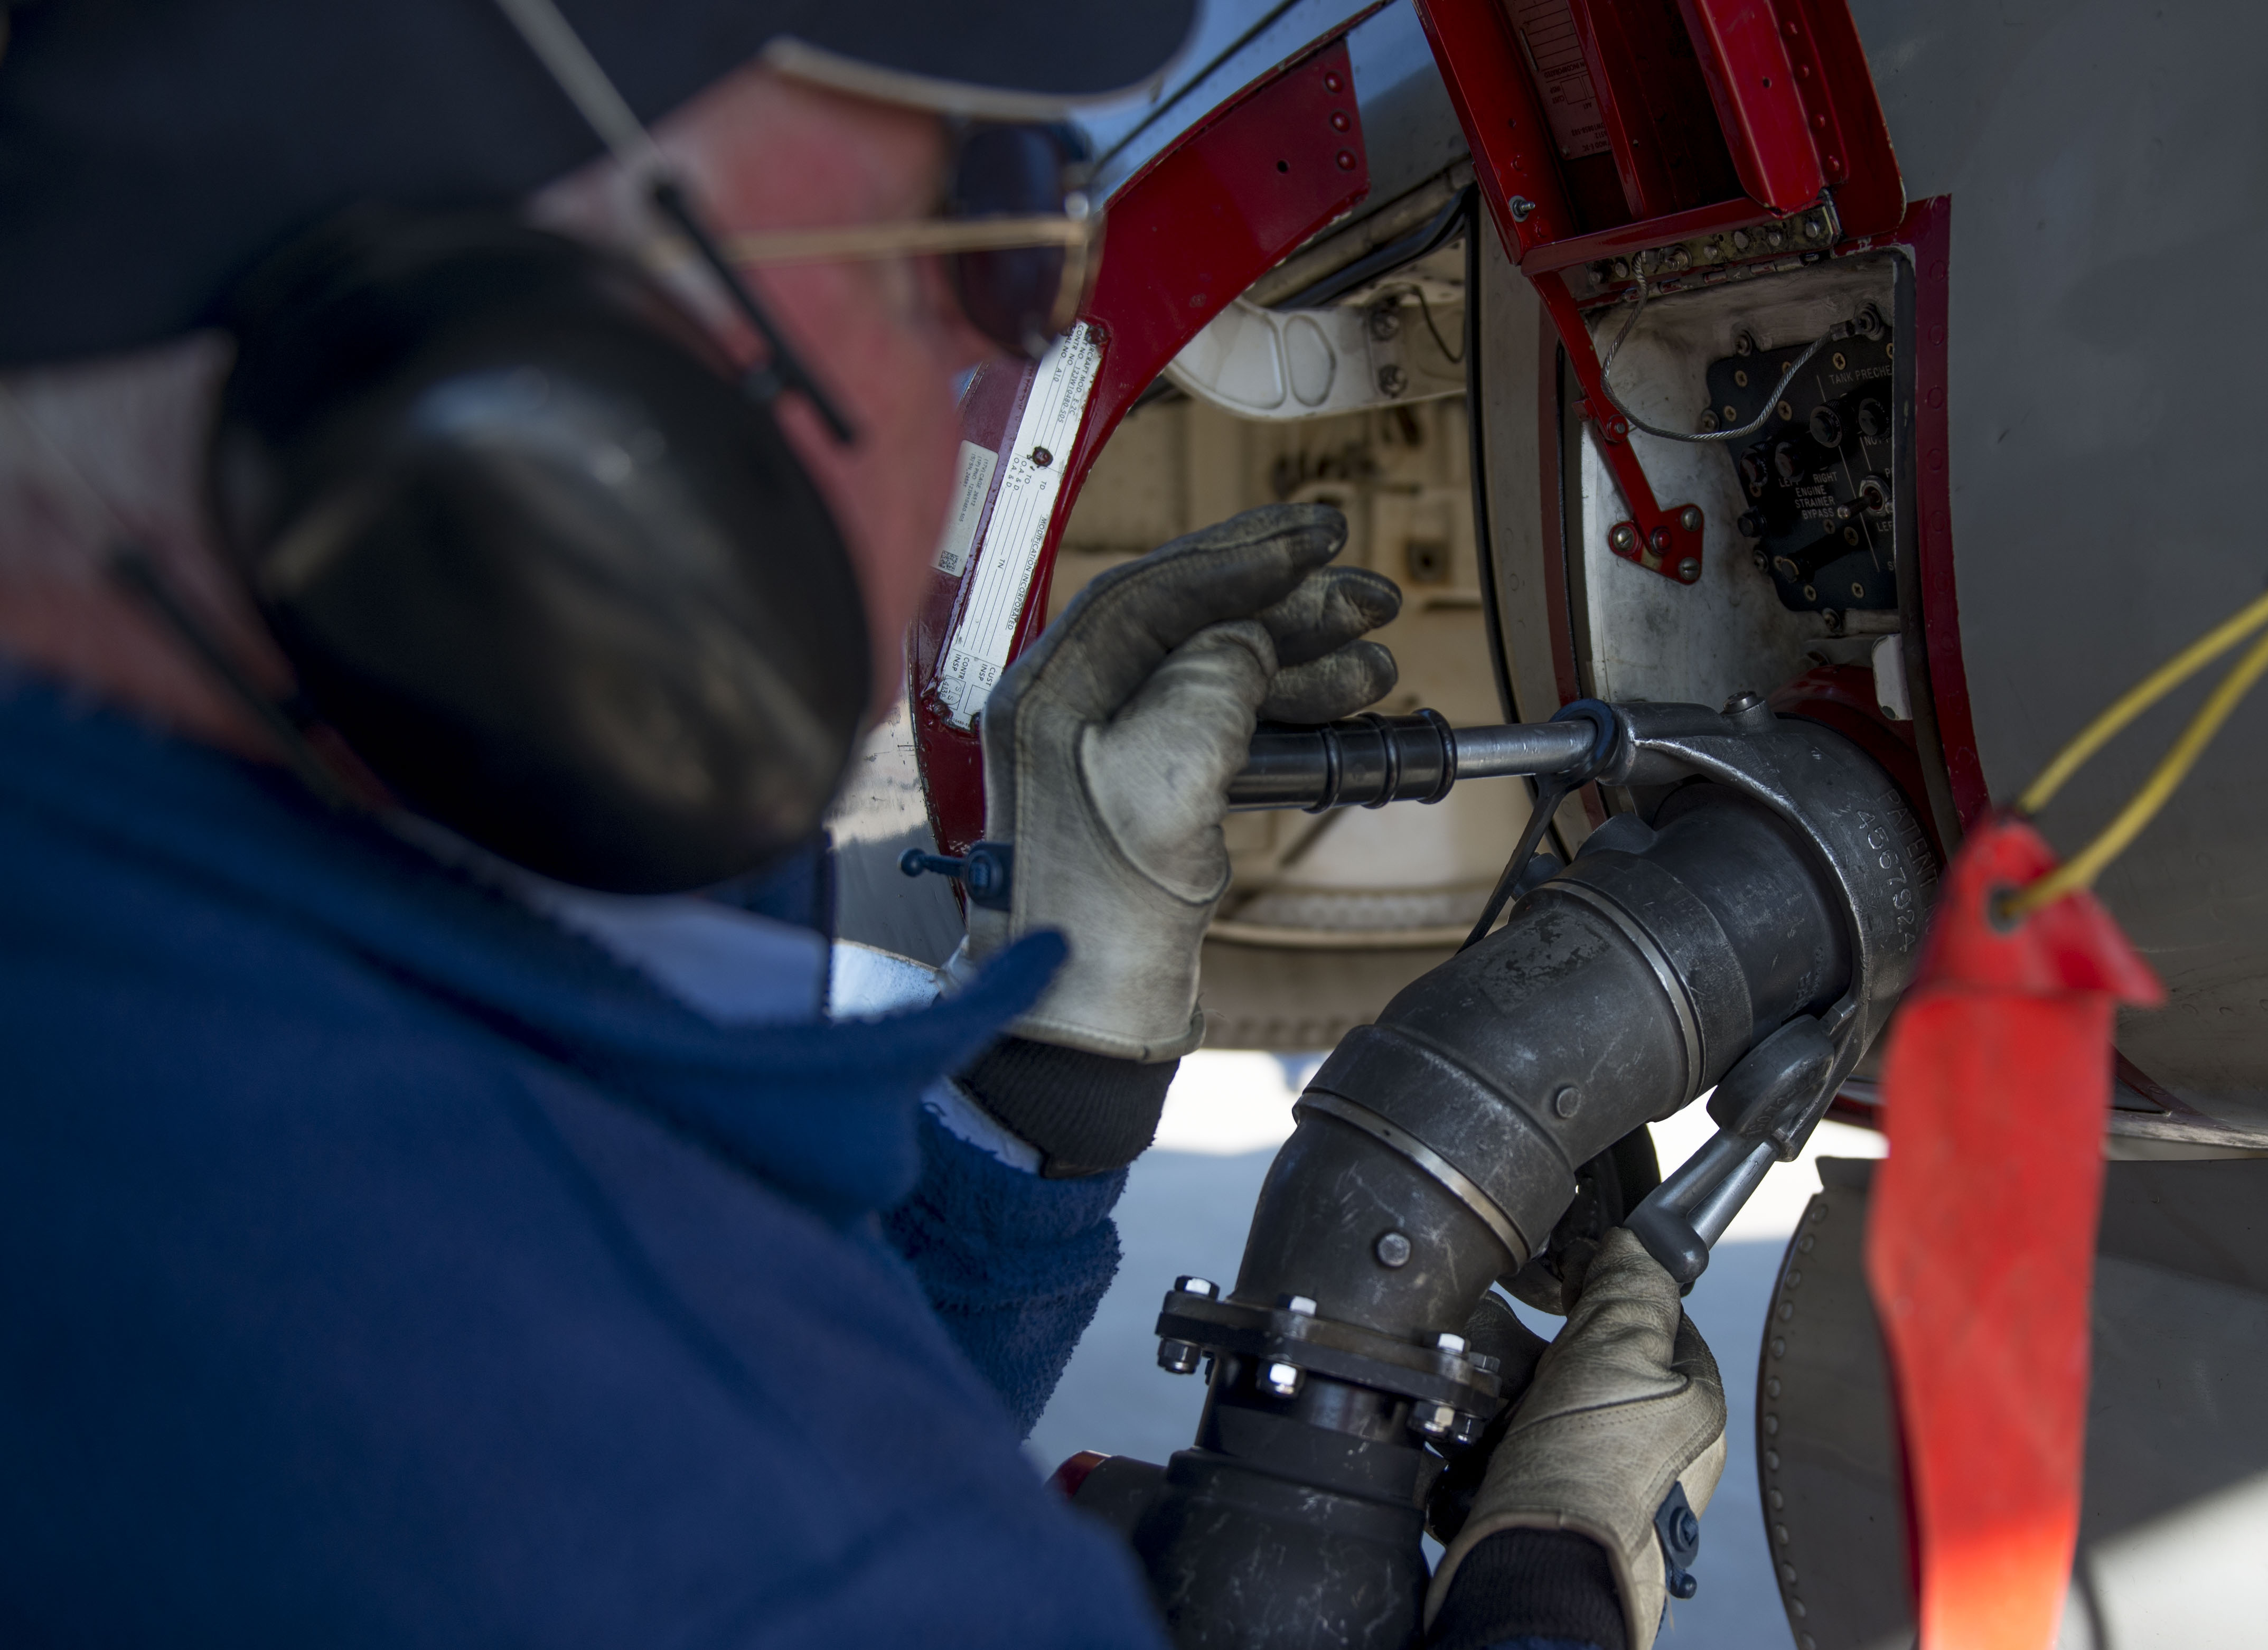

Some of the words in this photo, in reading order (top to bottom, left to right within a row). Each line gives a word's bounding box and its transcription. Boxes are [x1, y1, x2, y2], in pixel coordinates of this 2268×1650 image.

[1072, 324, 1084, 350] CONTR
[1060, 345, 1069, 360] NO.
[1066, 353, 1075, 367] NO.
[1077, 347, 1086, 361] NO.
[1084, 344, 1095, 374] IRCRAFT
[1075, 374, 1086, 394] MOD.
[1829, 372, 1853, 385] TANK
[1057, 367, 1081, 423] 123W10480-505
[1070, 398, 1079, 416] E-2C
[976, 473, 985, 490] CAGE
[1024, 474, 1032, 484] TO
[1039, 481, 1047, 491] TD
[1813, 472, 1837, 484] RIGHT
[1795, 485, 1827, 498] ENGINE
[1794, 495, 1835, 508] STRAINER
[1802, 508, 1834, 519] BYPASS
[1025, 517, 1048, 572] MODIFICATION
[997, 558, 1005, 569] TN
[1006, 573, 1030, 631] INCORPORATED
[952, 653, 961, 671] INSP
[958, 657, 970, 680] CONTR
[978, 663, 988, 681] INSP
[986, 667, 996, 687] CUST
[1877, 790, 1939, 888] PATENT
[1856, 810, 1916, 952] 4567924
